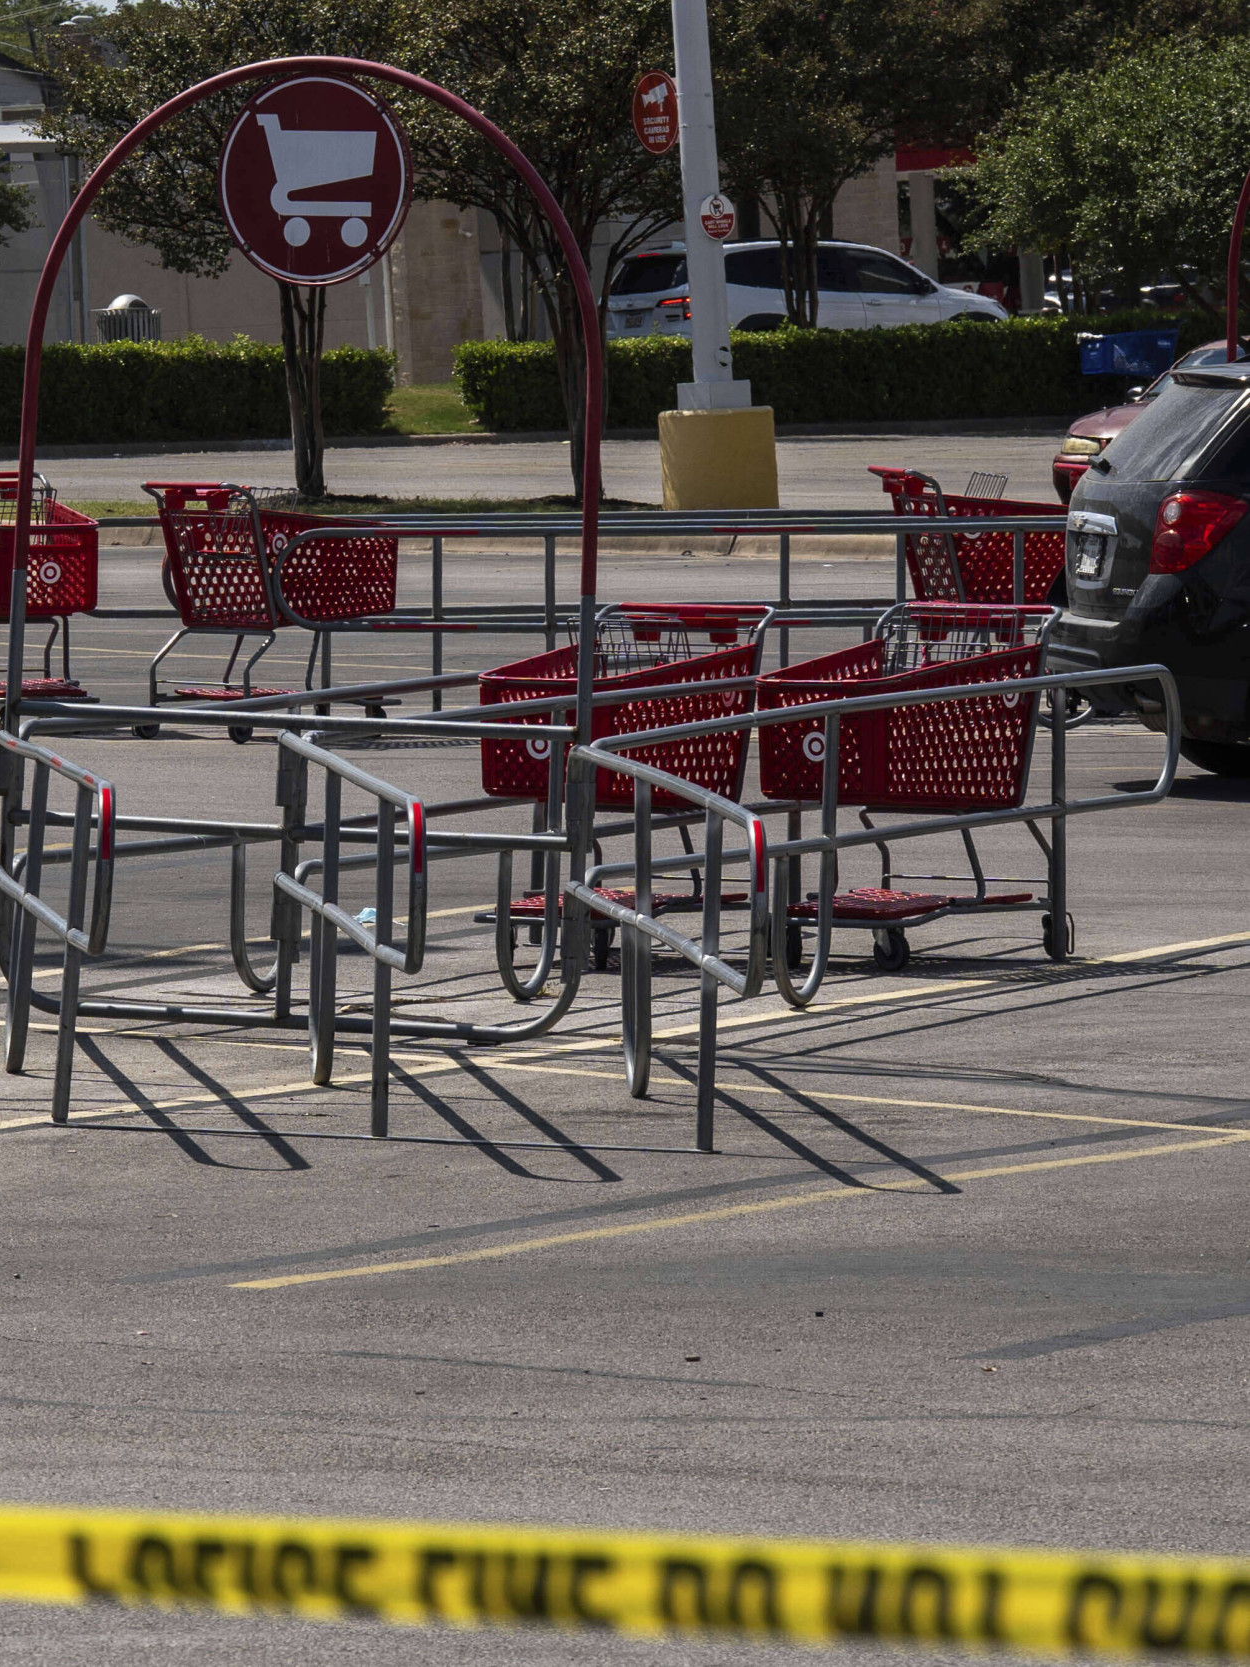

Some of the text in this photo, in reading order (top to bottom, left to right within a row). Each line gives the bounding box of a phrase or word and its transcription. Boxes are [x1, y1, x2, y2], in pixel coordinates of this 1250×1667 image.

[643, 116, 669, 125] SECURITY
[644, 126, 669, 134] CAMERAS
[655, 135, 667, 143] USE
